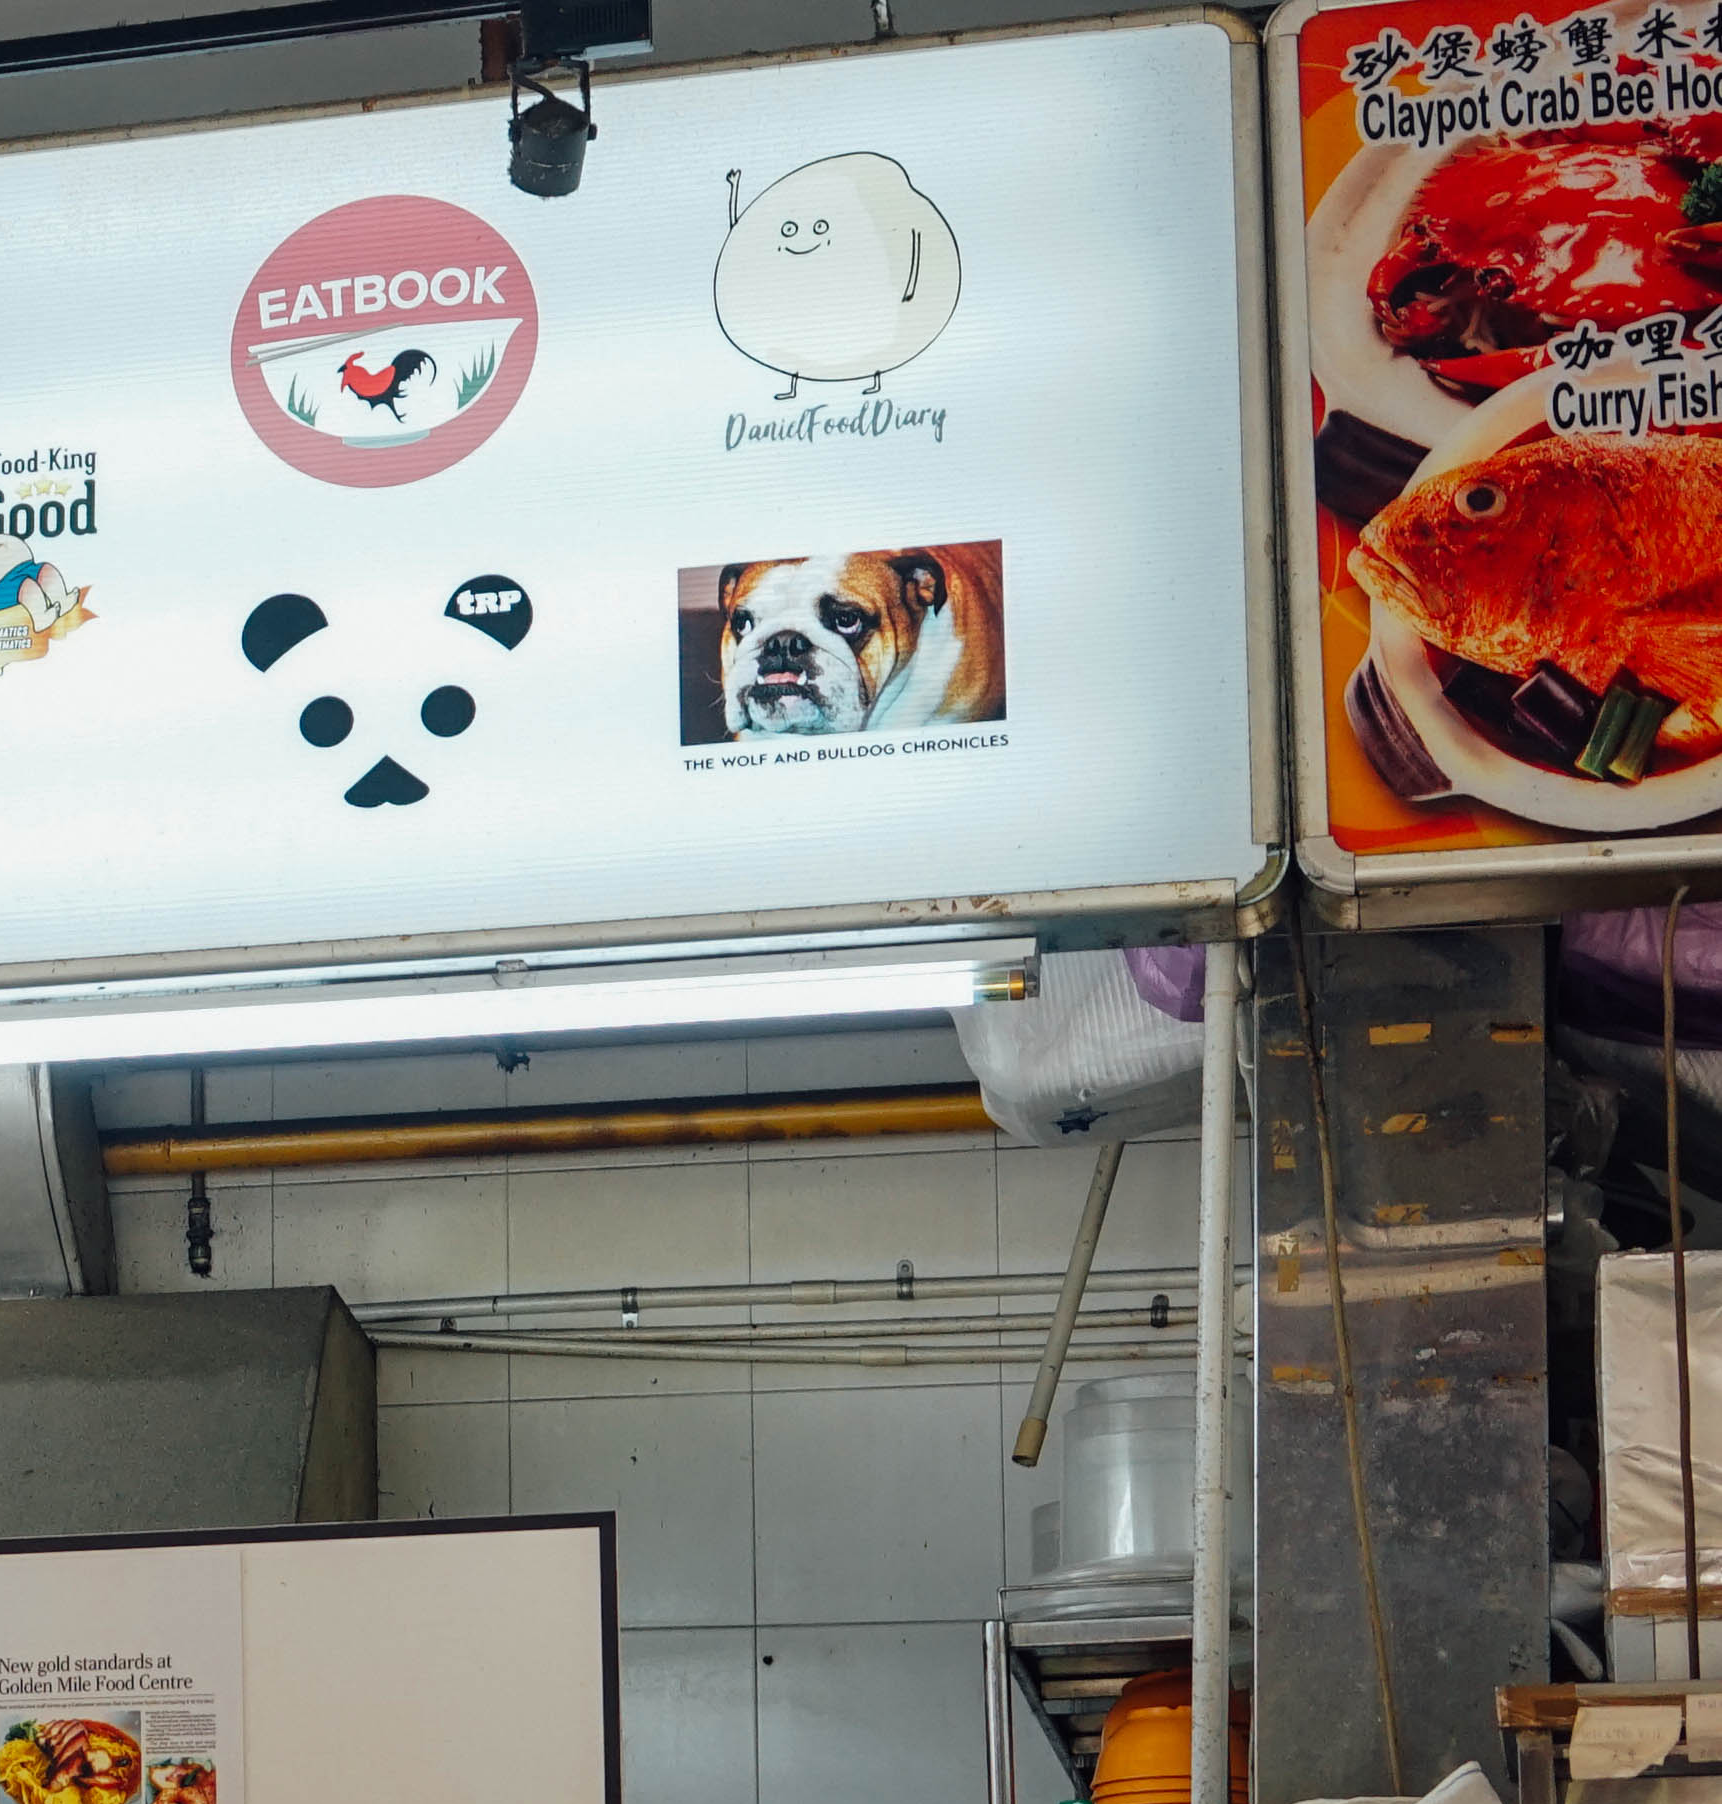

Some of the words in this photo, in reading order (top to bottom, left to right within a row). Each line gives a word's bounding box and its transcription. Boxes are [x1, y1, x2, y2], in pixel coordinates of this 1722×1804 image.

[1362, 86, 1490, 148] Claypot
[1500, 79, 1580, 127] Crab
[1591, 71, 1654, 118] Bee
[257, 265, 508, 330] EATBOOK
[724, 398, 947, 452] DanielFoodDiary
[1552, 381, 1646, 437] Curry
[684, 758, 714, 772] THE
[721, 753, 768, 768] WOLF
[773, 750, 810, 764] AND
[817, 743, 895, 761] BULLDOG
[901, 734, 1009, 754] CHRONICLES
[38, 1655, 70, 1677] gold
[75, 1653, 153, 1673] standards
[157, 1654, 172, 1670] at
[57, 1677, 92, 1694] Mile
[95, 1674, 135, 1692] Food
[139, 1673, 194, 1691] Centre
